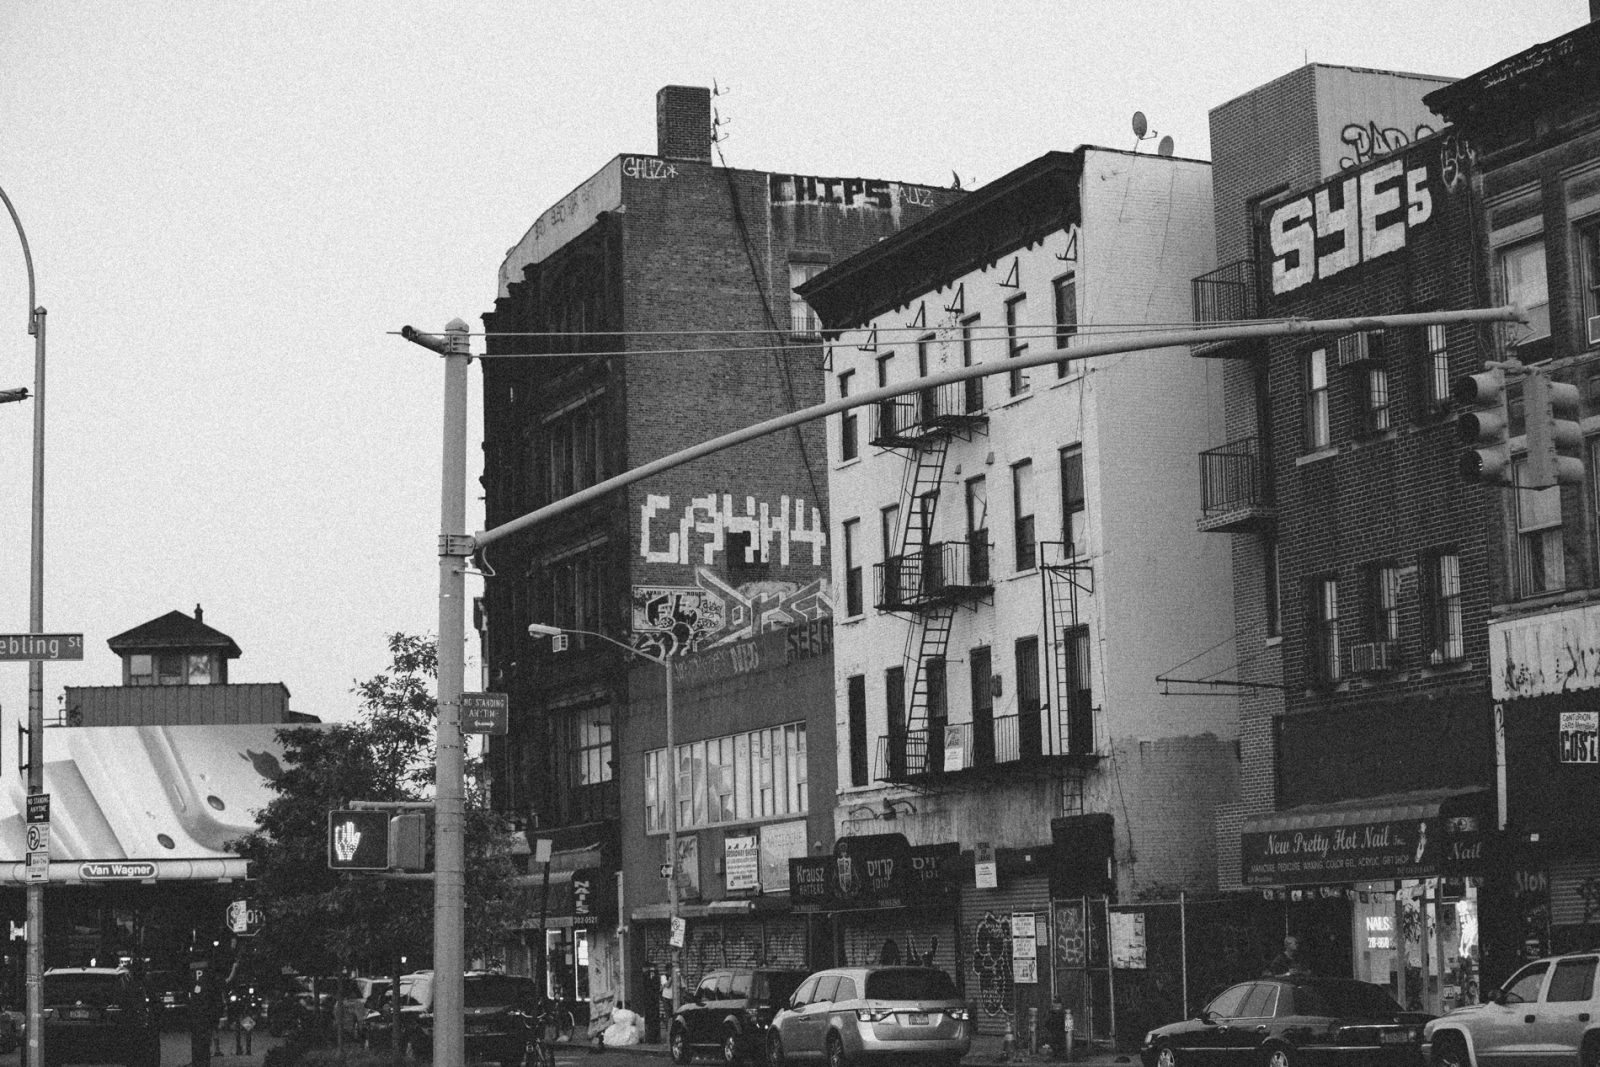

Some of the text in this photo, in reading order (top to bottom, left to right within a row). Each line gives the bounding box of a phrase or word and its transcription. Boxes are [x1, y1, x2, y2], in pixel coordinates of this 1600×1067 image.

[0, 636, 81, 659] ebling St
[1264, 834, 1290, 855] New
[1293, 832, 1330, 858] Pretty
[1333, 828, 1358, 851] Hot
[1361, 825, 1390, 848] Nail
[1447, 841, 1482, 860] Nail
[88, 865, 151, 877] Van Wagner
[796, 865, 824, 883] Krausz
